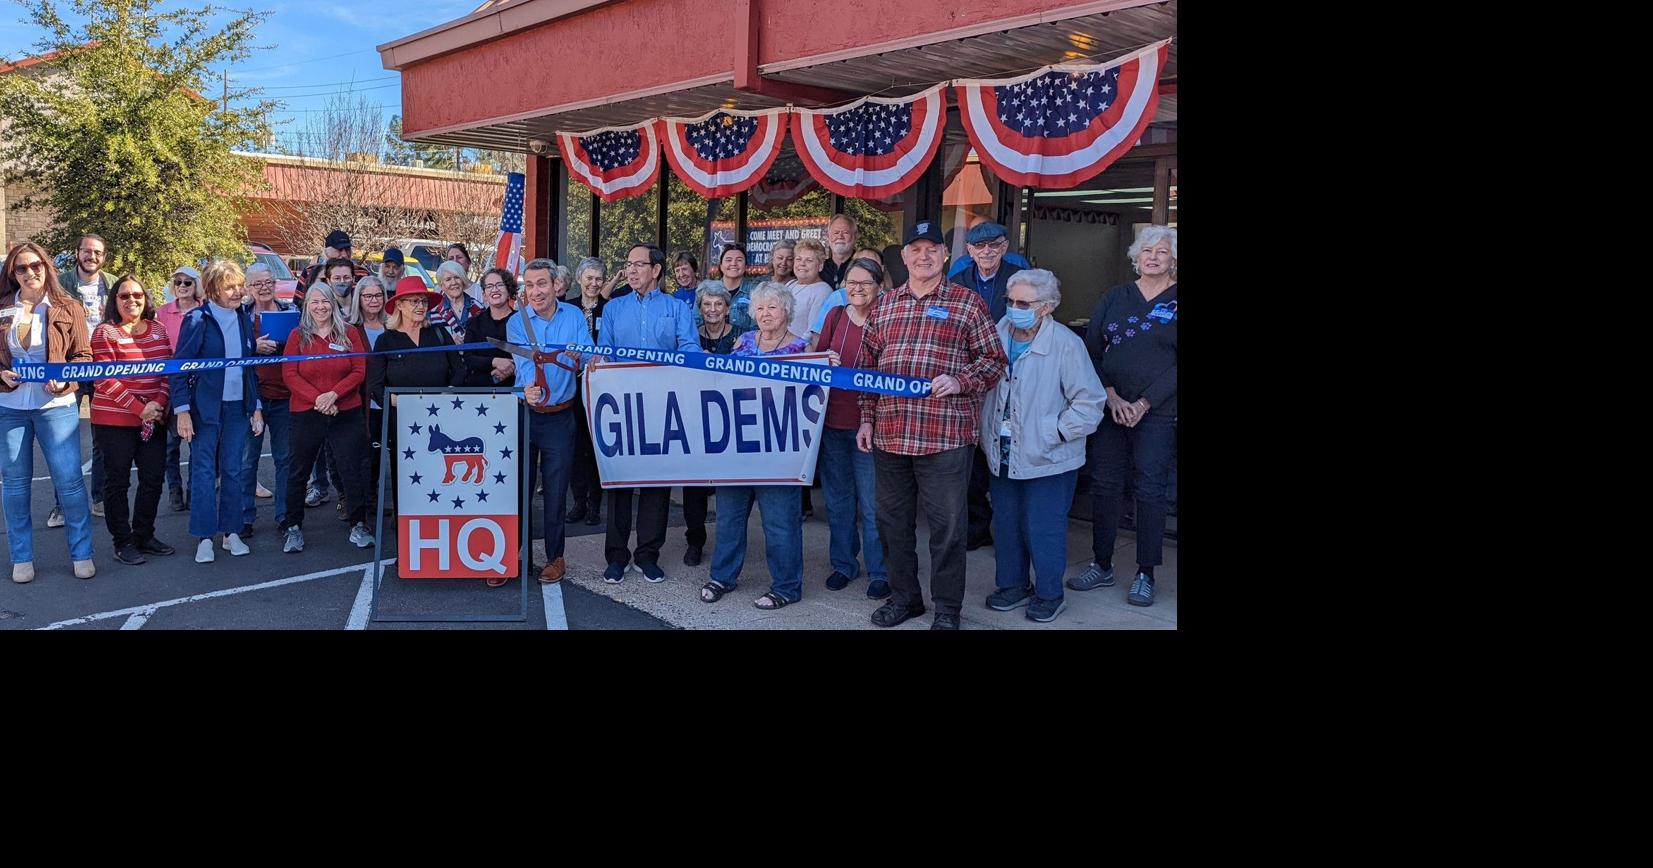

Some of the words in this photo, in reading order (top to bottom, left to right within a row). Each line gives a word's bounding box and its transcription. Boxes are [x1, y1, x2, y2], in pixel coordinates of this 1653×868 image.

[749, 231, 766, 240] COME
[767, 230, 784, 240] MEET
[785, 230, 800, 240] AND
[801, 228, 821, 240] GREET
[746, 241, 778, 252] DEMOCRA
[566, 343, 613, 355] GRAND
[616, 348, 686, 365] OPENING
[61, 365, 104, 379] GRAND
[104, 362, 166, 376] OPENING
[180, 360, 224, 371] GRAND
[705, 356, 756, 373] GRAND
[759, 362, 832, 383] OPENING
[853, 372, 906, 392] GRAND
[595, 390, 691, 458] GILA
[701, 384, 827, 453] DEMS
[408, 517, 508, 576] HQ
